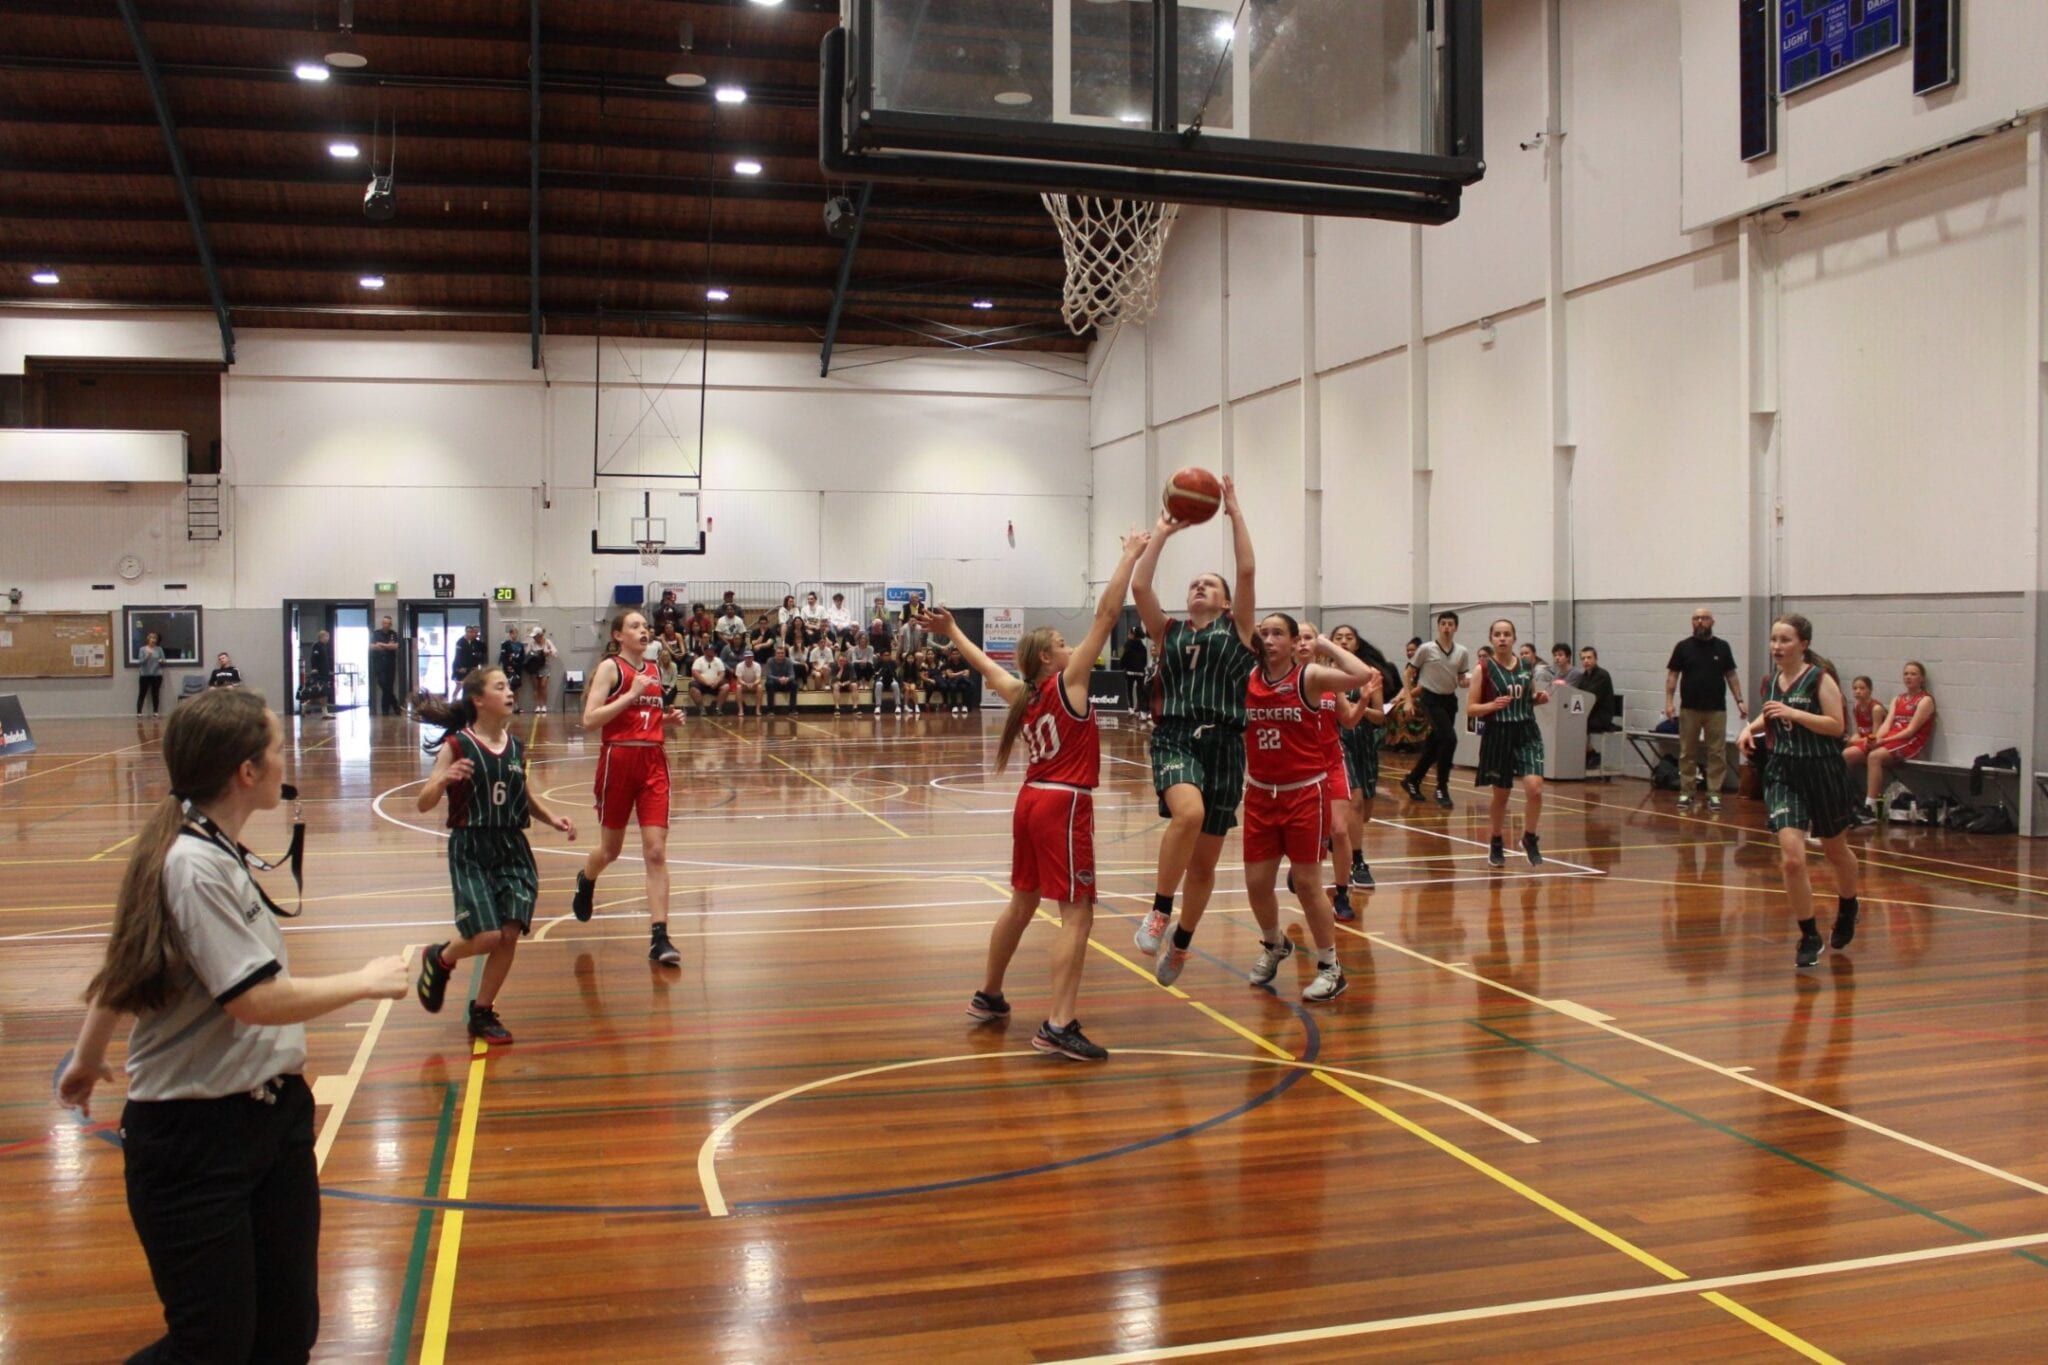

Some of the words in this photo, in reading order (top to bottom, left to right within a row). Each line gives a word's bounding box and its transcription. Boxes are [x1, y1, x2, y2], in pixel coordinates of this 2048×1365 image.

[1783, 30, 1809, 50] LIGHT
[497, 589, 512, 599] 20
[1185, 645, 1201, 670] 7
[1508, 684, 1523, 699] 10
[1573, 700, 1582, 712] A
[640, 711, 650, 730] 7
[1023, 713, 1060, 764] 10
[1256, 728, 1281, 749] 22
[493, 781, 506, 806] 6
